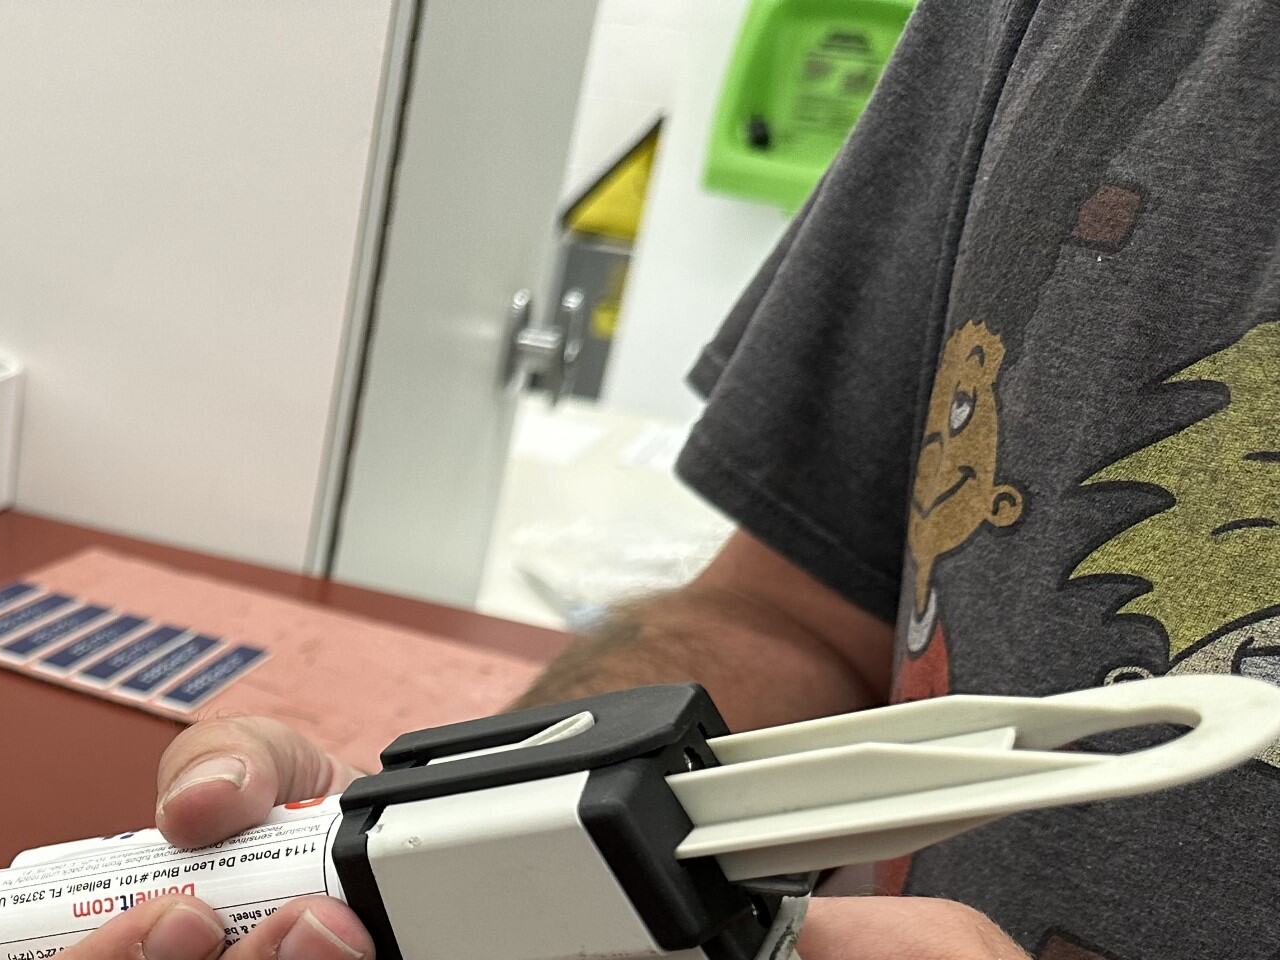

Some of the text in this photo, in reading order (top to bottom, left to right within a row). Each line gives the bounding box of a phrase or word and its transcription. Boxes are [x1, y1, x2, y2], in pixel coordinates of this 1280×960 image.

[240, 848, 280, 863] Ponce
[285, 842, 316, 857] 1114
[184, 859, 214, 873] Leon
[219, 856, 235, 867] De
[67, 878, 111, 893] Belleair,
[10, 892, 45, 905] 33756,
[49, 889, 63, 898] FL
[229, 909, 262, 922] sheet.
